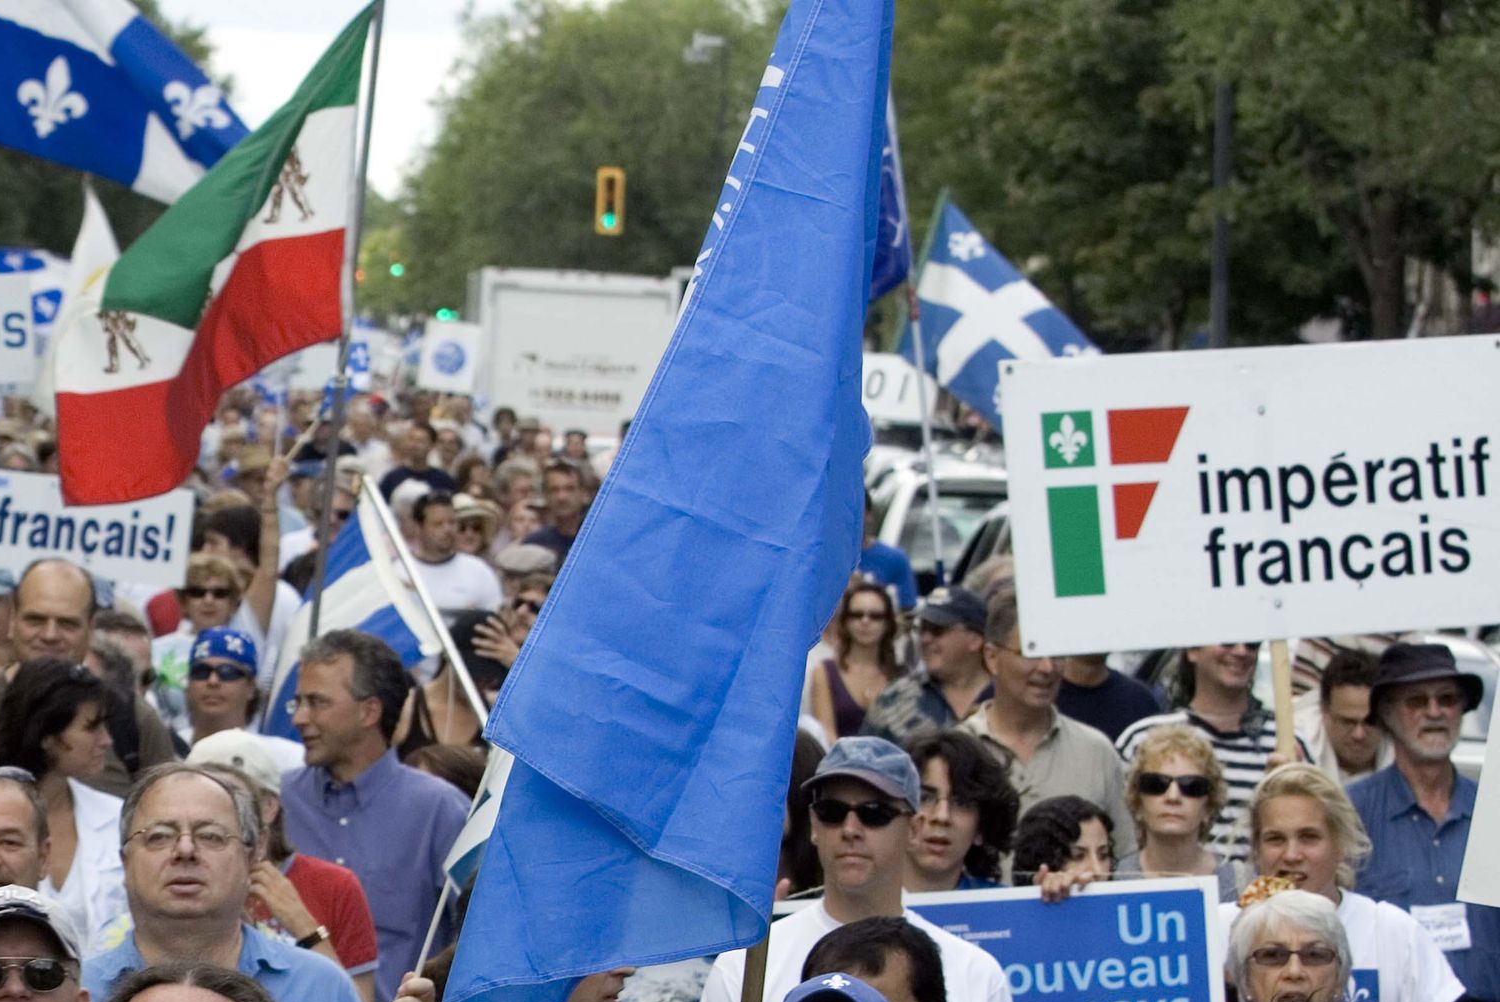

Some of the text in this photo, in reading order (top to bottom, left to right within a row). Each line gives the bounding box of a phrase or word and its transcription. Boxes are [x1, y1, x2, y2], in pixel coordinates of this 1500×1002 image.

[1198, 436, 1490, 524] impératif
[1204, 514, 1472, 590] français
[1117, 903, 1186, 945] Un
[1005, 954, 1189, 996] ouveau
